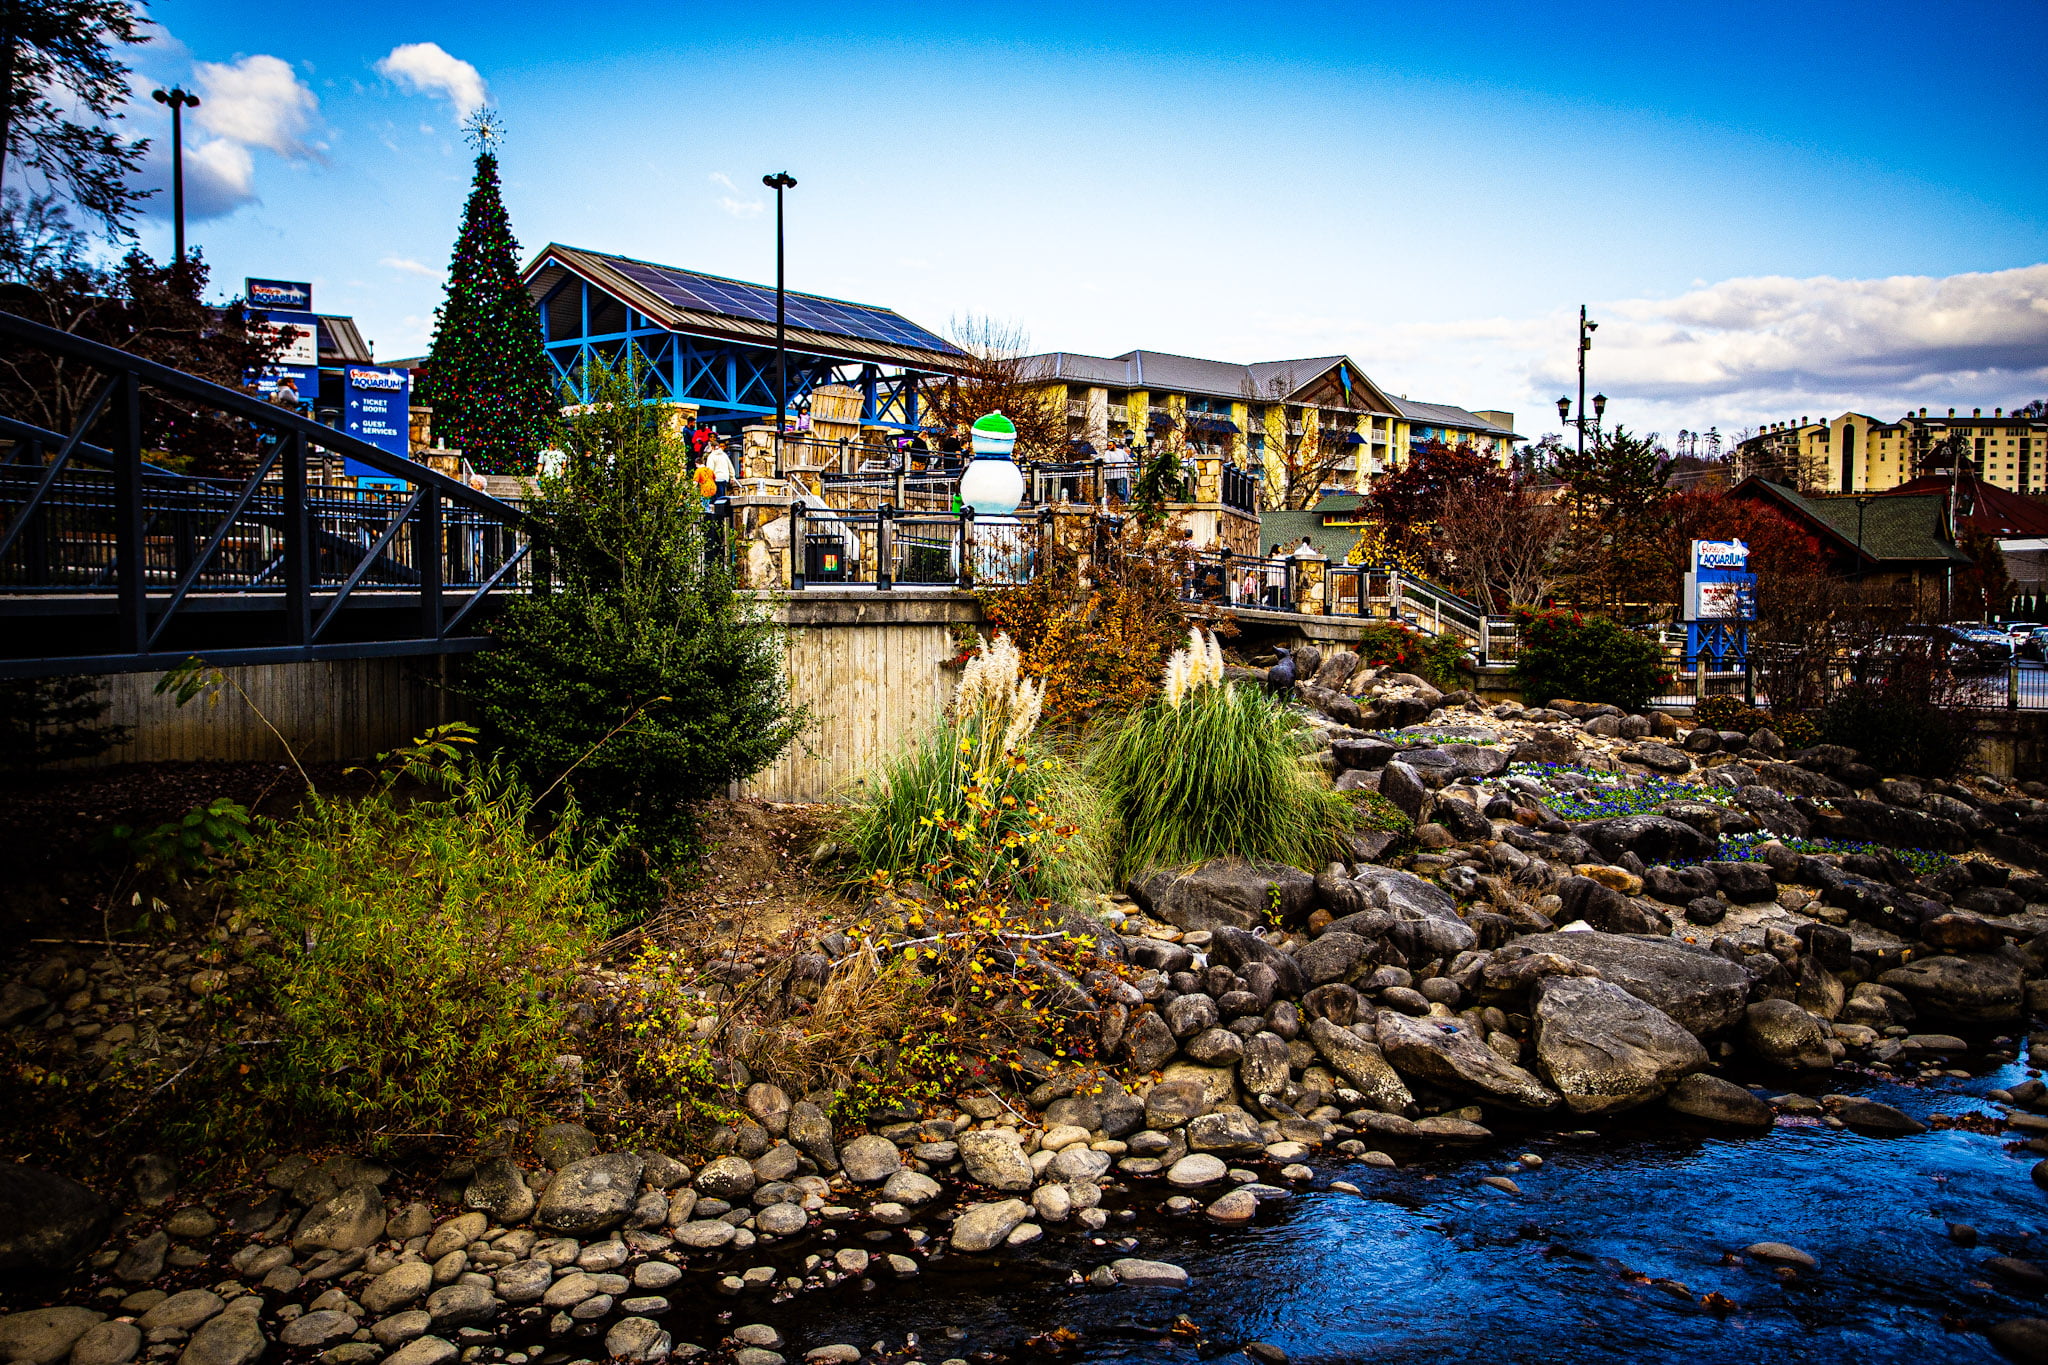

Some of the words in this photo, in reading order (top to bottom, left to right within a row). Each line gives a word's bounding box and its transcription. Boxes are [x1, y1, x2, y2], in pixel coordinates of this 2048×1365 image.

[354, 378, 400, 388] AQUARIUM
[363, 398, 388, 406] TICKET
[363, 405, 388, 413] BOOTH
[362, 420, 386, 428] GUEST
[363, 427, 397, 436] SERVICES
[1703, 553, 1745, 566] AQUARIUM
